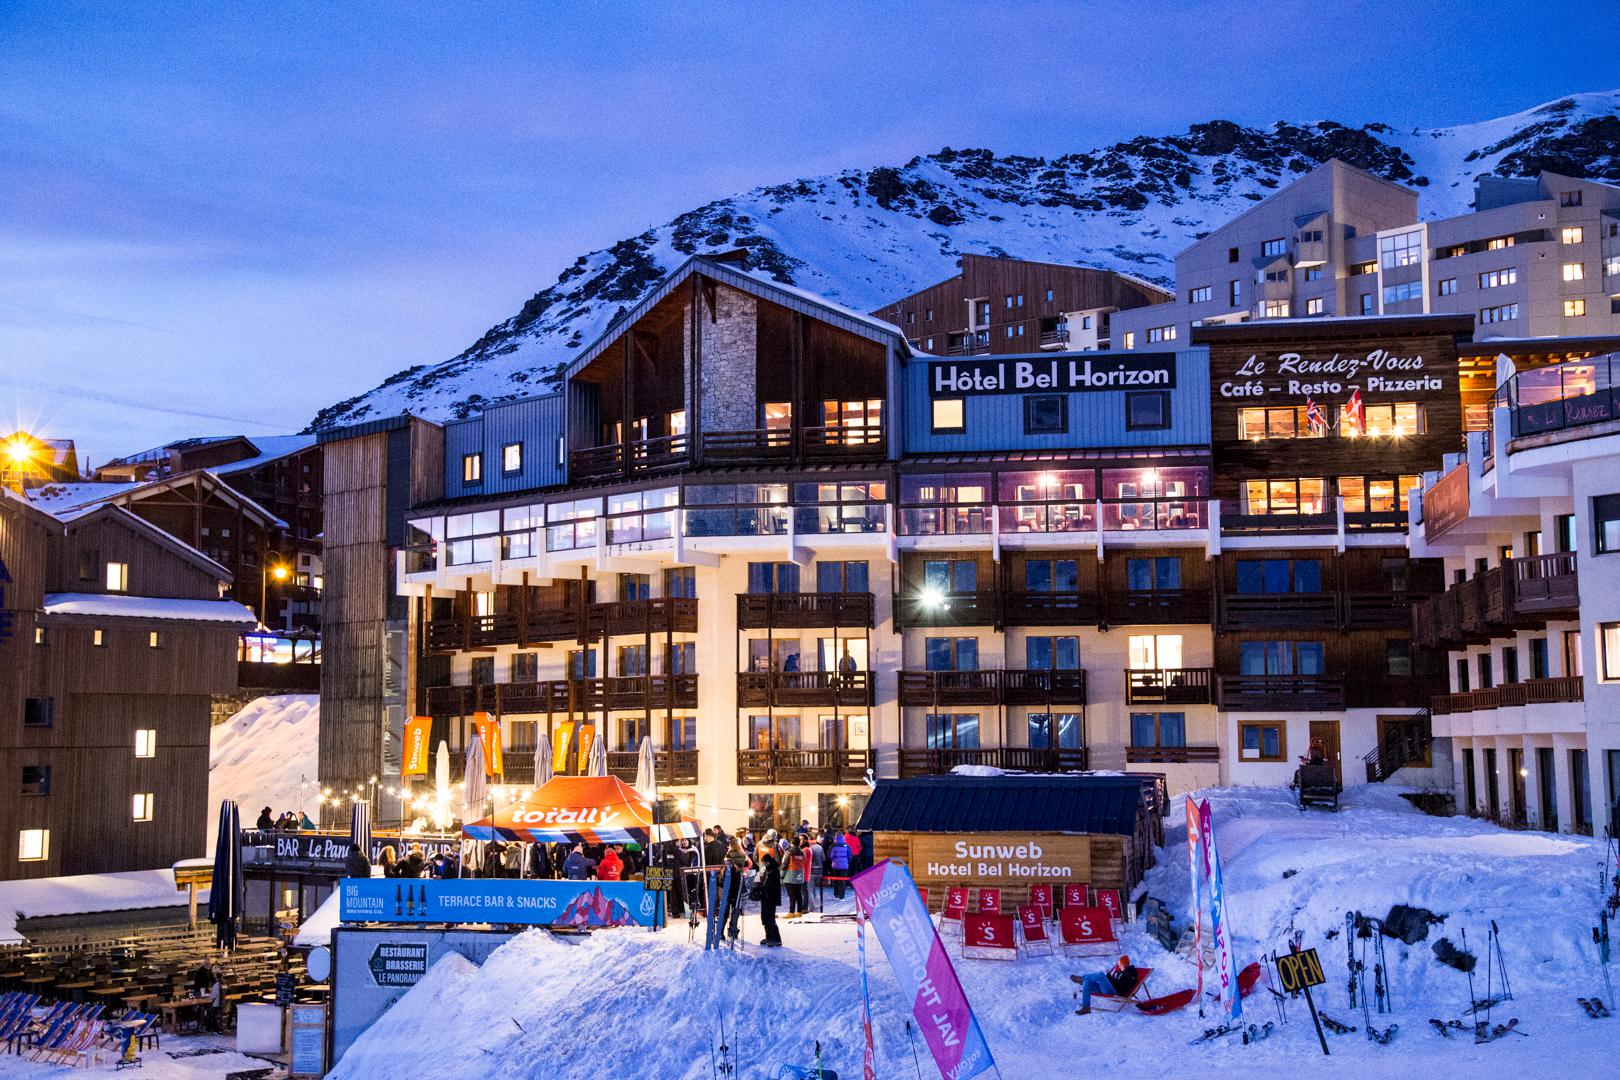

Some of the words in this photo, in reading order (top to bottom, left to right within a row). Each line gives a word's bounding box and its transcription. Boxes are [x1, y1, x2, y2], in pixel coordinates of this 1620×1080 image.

[1235, 354, 1265, 376] Le
[1278, 349, 1424, 378] Rendez-Vous
[935, 363, 1005, 392] Hôtel
[1016, 360, 1058, 389] Bel
[1069, 360, 1169, 387] Horizon
[1220, 380, 1264, 397] Café
[1288, 380, 1342, 396] Resto
[1367, 375, 1443, 392] Pizzeria
[408, 727, 422, 770] Sunweb
[511, 805, 620, 827] totally
[277, 838, 299, 857] BAR
[308, 838, 322, 858] Le
[954, 841, 1043, 859] Sunweb
[927, 862, 972, 877] Hotel
[978, 863, 1002, 877] Bel
[1008, 863, 1072, 877] Horizon
[346, 885, 359, 897] BIG
[346, 897, 384, 909] MOUNTAIN
[438, 895, 482, 907] TERRACE
[484, 896, 504, 908] BAR
[506, 896, 514, 908] &
[517, 896, 557, 909] SNACKS
[380, 947, 425, 958] RESTAURANT
[385, 960, 425, 970] BRASSERIE
[1278, 951, 1325, 990] OPEN
[378, 972, 386, 983] LE
[387, 972, 424, 983] PANORAMI
